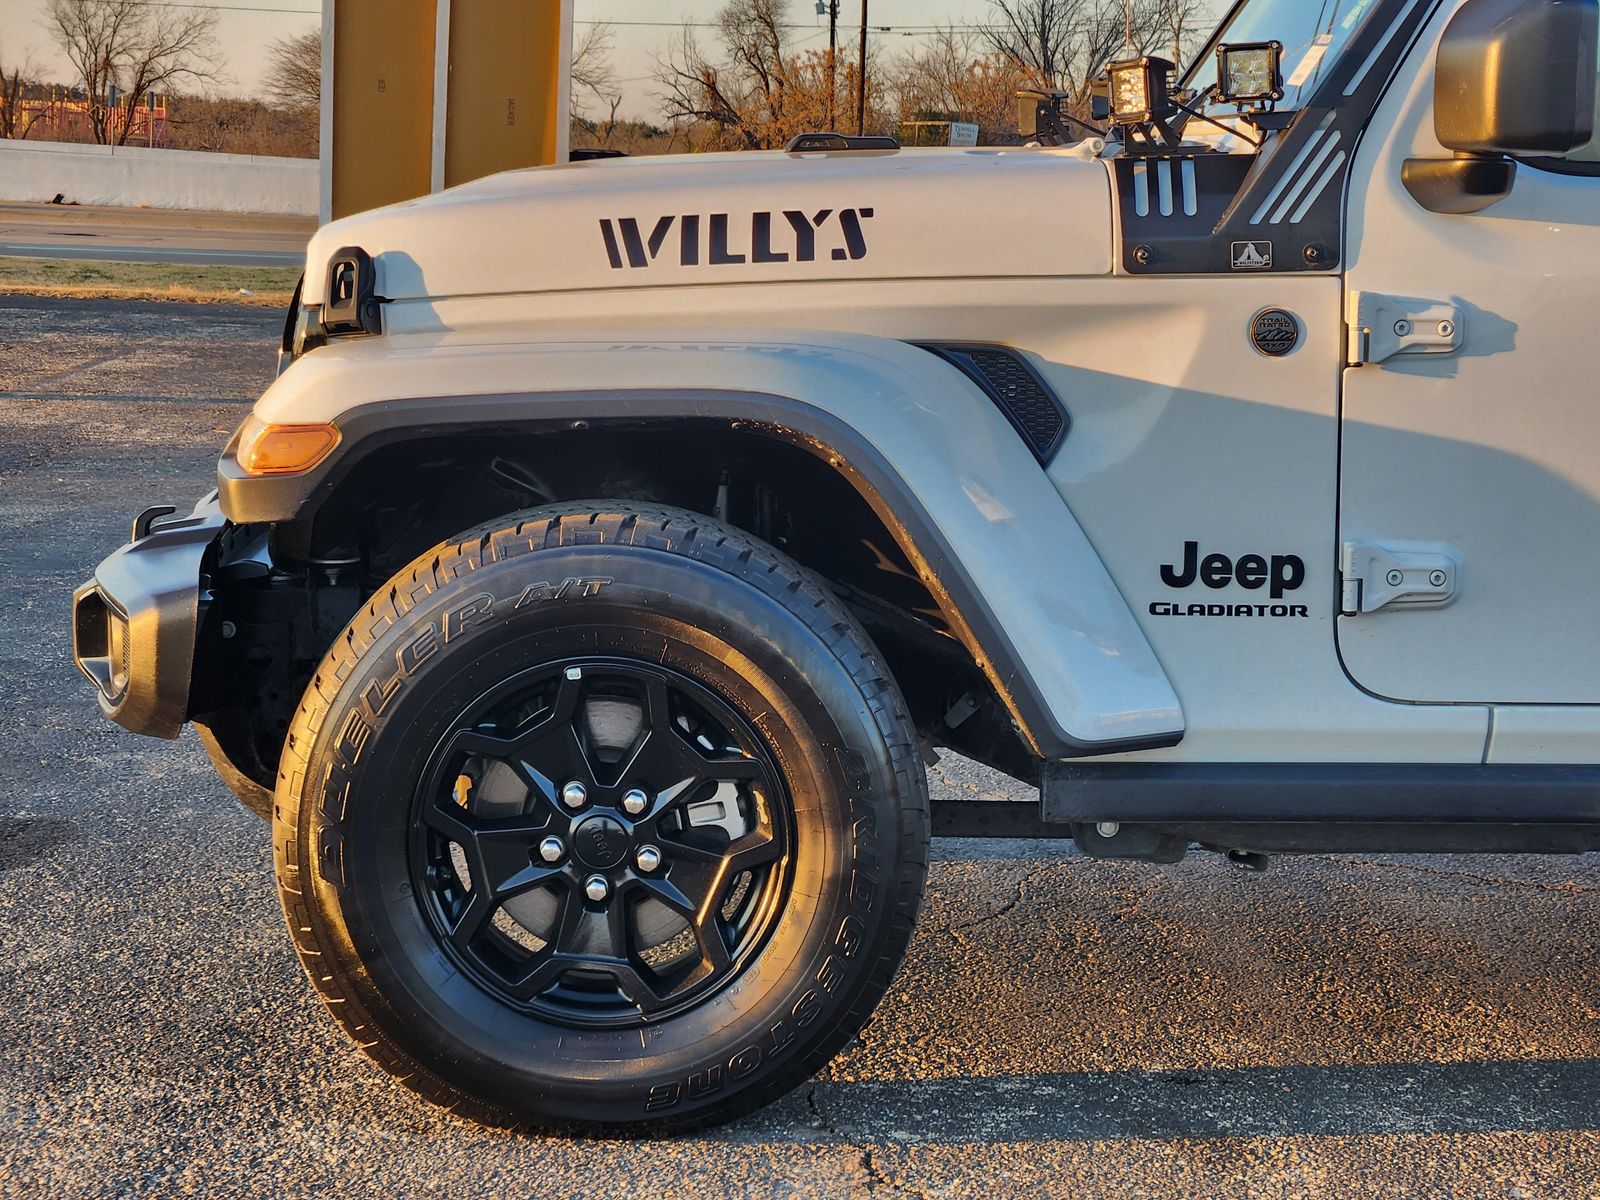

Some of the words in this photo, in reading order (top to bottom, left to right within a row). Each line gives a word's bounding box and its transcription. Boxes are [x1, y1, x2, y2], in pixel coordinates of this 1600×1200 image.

[599, 208, 874, 269] WILLYS
[1160, 541, 1305, 599] Jeep
[1149, 602, 1310, 618] GLADIATOR
[317, 591, 497, 889] DUELER
[513, 576, 614, 609] A/T
[643, 745, 880, 1112] BRIDGESTONE
